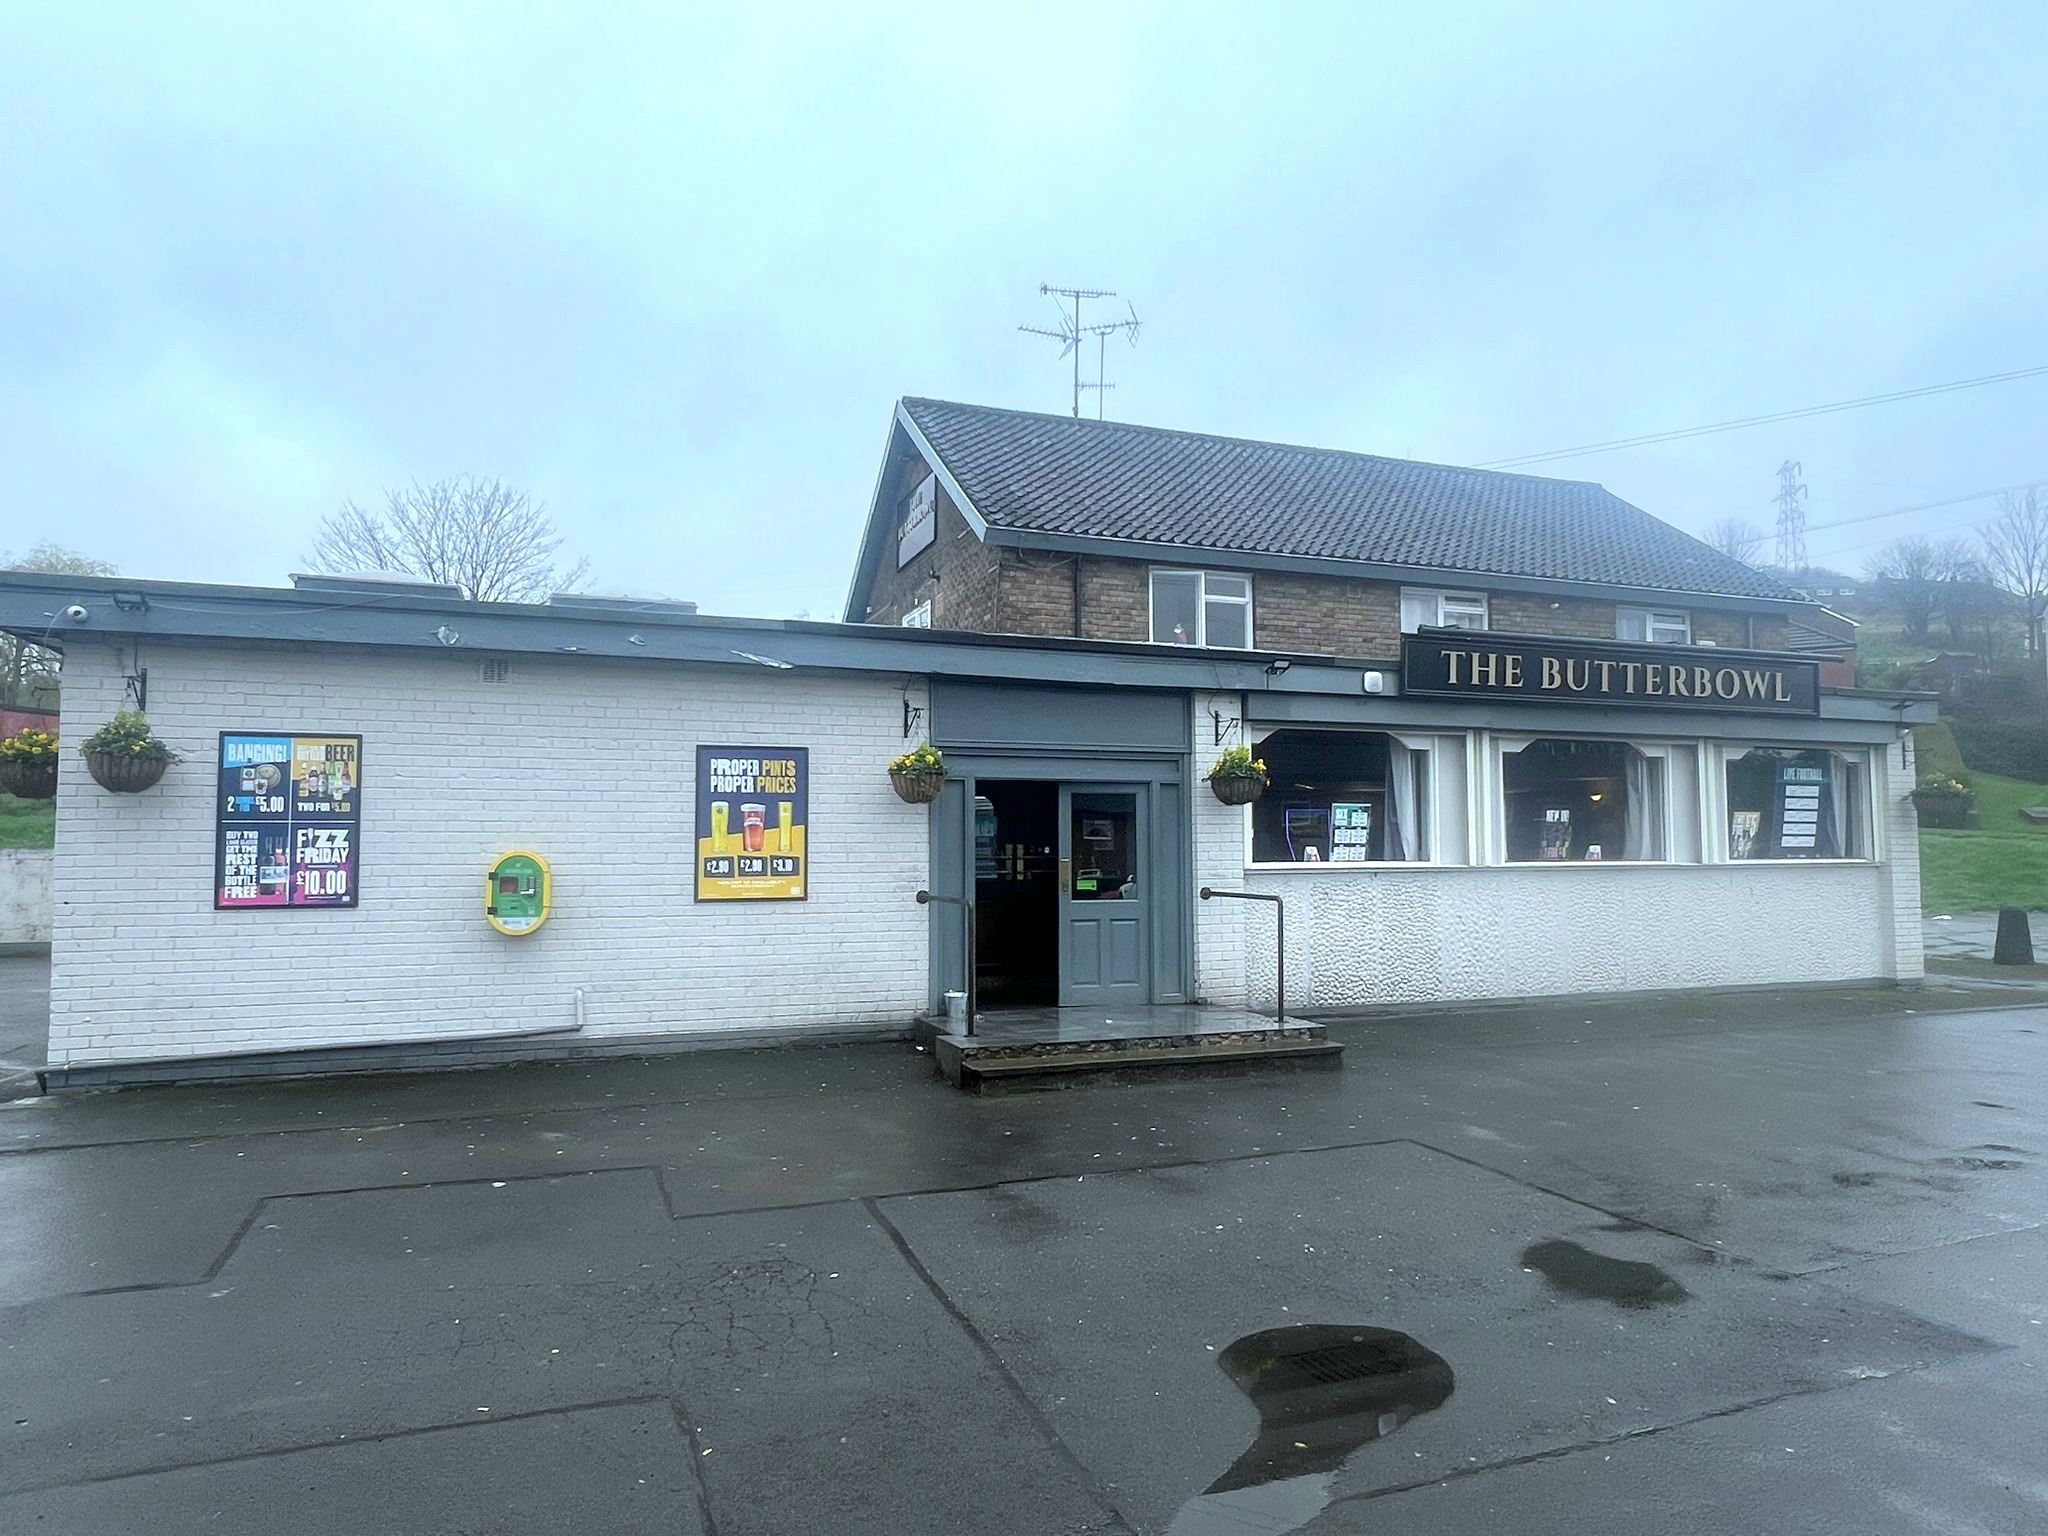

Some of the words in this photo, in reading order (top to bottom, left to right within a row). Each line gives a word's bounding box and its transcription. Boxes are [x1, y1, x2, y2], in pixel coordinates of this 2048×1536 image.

[1441, 650, 1524, 687] THE
[1540, 656, 1792, 702] BUTTERBOWL
[227, 743, 287, 763] BANGING!
[325, 744, 355, 762] BEER
[710, 758, 760, 776] PROPER
[762, 759, 797, 777] PINTS
[710, 775, 755, 793] PROPER
[756, 776, 797, 794] PRICES
[227, 796, 235, 812] 2
[255, 796, 285, 813] £5.00
[225, 853, 258, 865] REST
[296, 847, 350, 864] FRIDAY
[225, 865, 238, 875] OF
[238, 865, 258, 876] THE
[295, 870, 347, 895] £10.00
[224, 886, 258, 899] FREE
